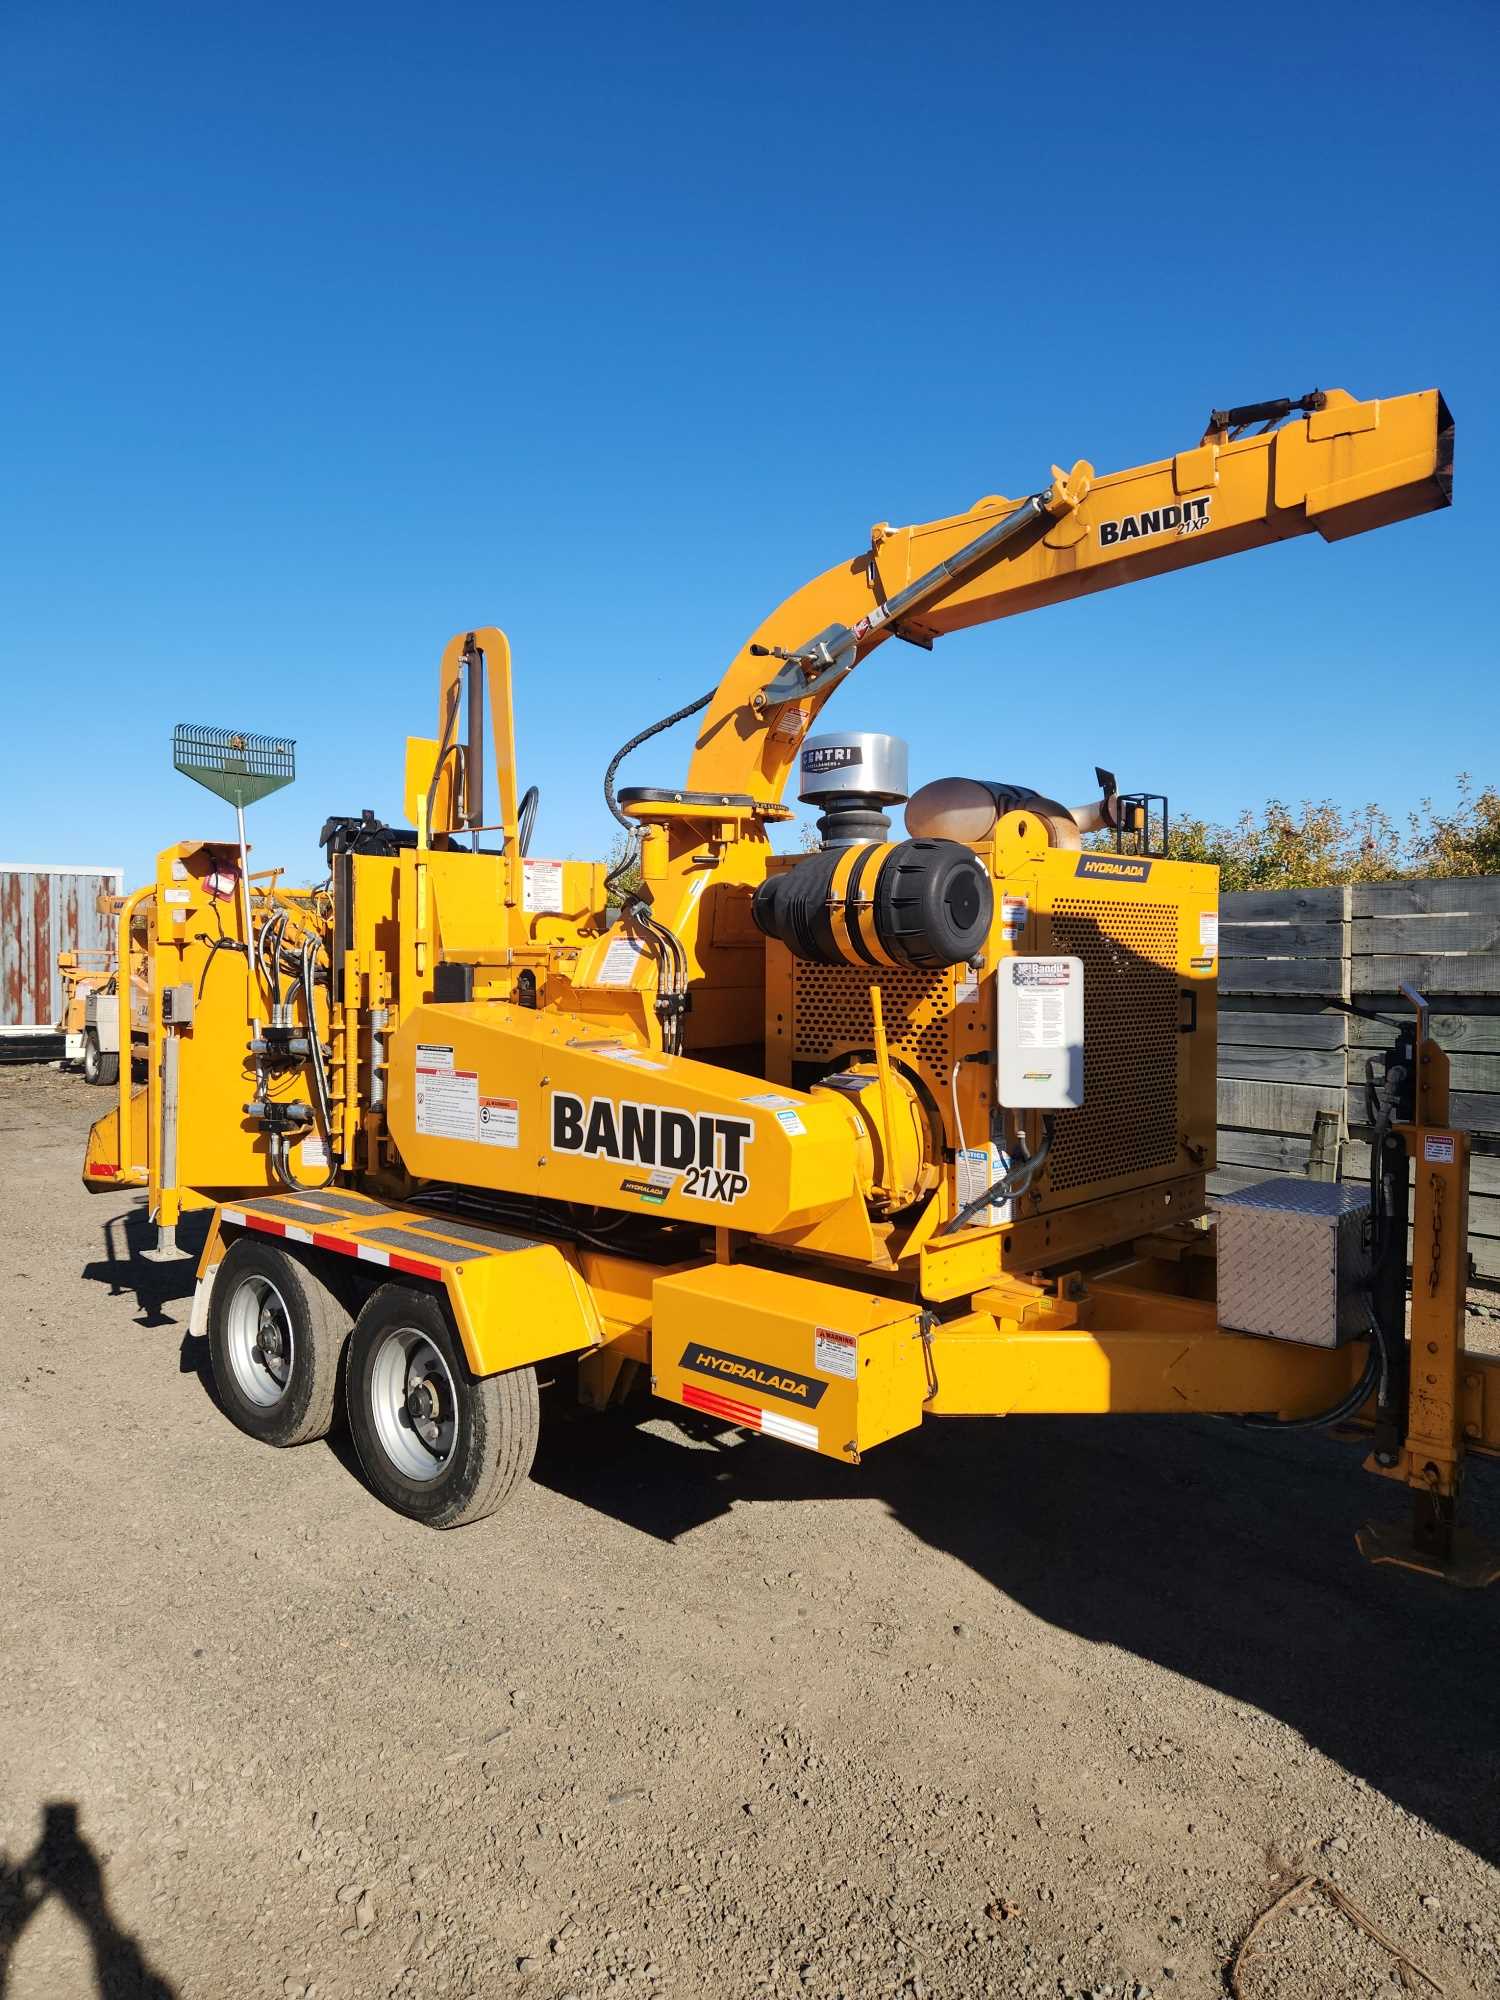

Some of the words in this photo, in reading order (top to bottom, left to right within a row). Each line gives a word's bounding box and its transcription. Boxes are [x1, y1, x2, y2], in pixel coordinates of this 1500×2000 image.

[1100, 497, 1210, 546] BANDIT
[1176, 516, 1210, 536] 21XP
[1084, 861, 1145, 877] HYDRALADA
[552, 1094, 752, 1173] BANDIT
[683, 1166, 748, 1203] 21XP
[695, 1353, 808, 1398] HYDRALADA
